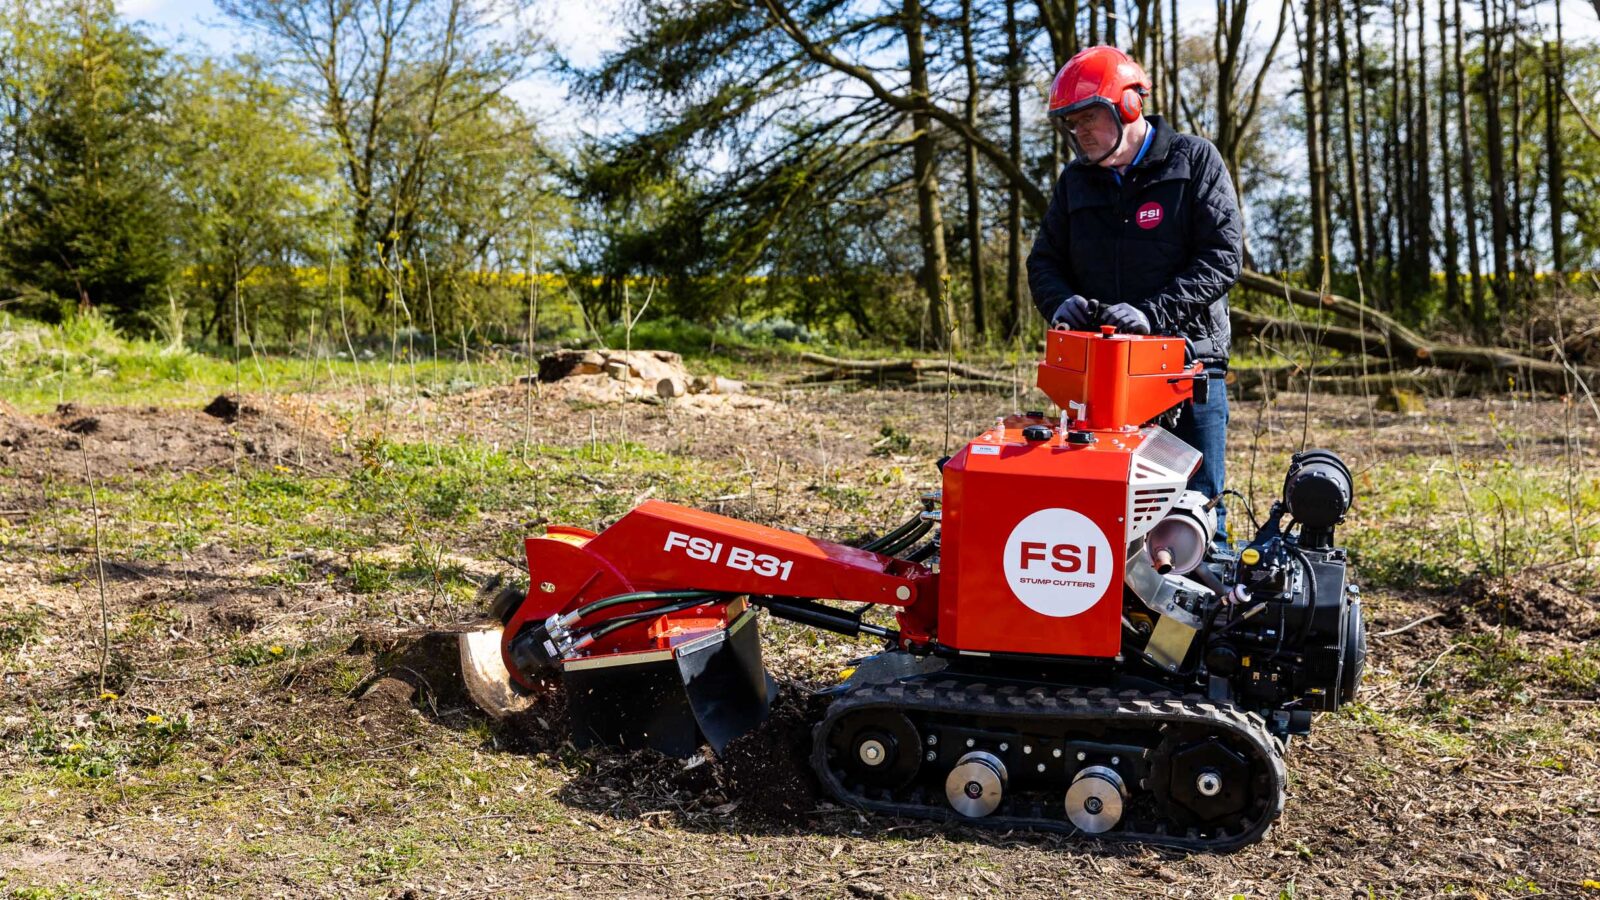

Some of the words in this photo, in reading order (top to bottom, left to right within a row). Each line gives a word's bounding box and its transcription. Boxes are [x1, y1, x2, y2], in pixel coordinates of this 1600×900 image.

[1139, 208, 1160, 220] FSI
[663, 531, 723, 564] FSI
[726, 546, 794, 581] B31
[1020, 541, 1096, 575] FSI
[1019, 577, 1052, 586] STUMP
[1052, 579, 1096, 589] CUTTERS
